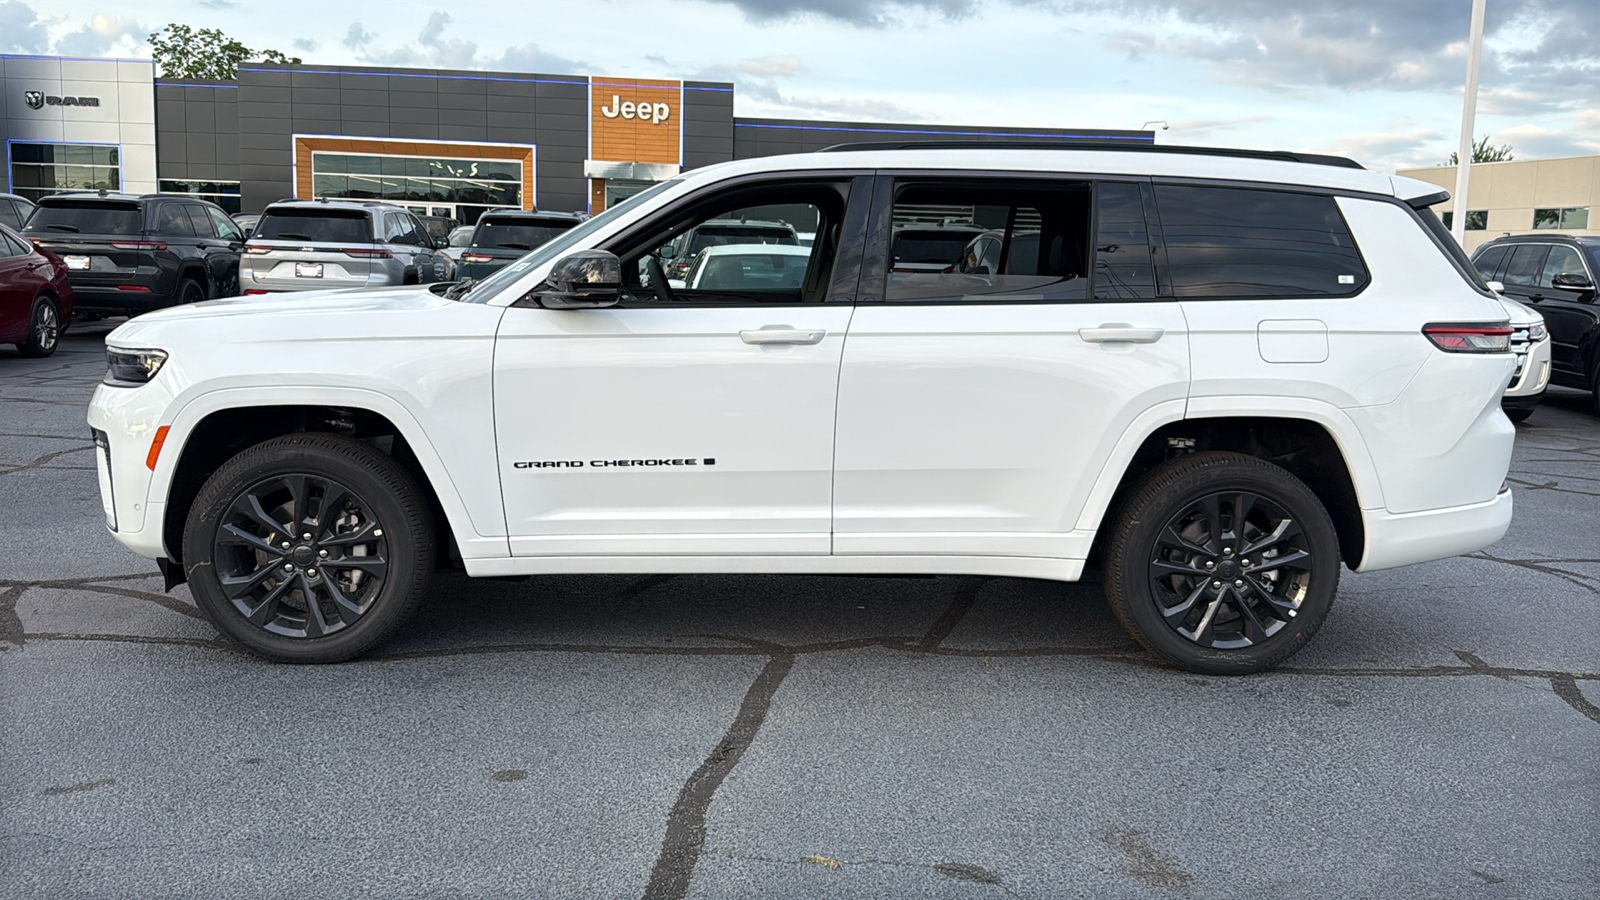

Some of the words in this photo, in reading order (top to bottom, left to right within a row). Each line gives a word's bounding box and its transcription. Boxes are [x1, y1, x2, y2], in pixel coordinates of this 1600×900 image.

[45, 95, 100, 108] RAM
[601, 94, 670, 125] Jeep
[513, 460, 584, 469] GRAND
[589, 458, 698, 468] CHEROKEE
